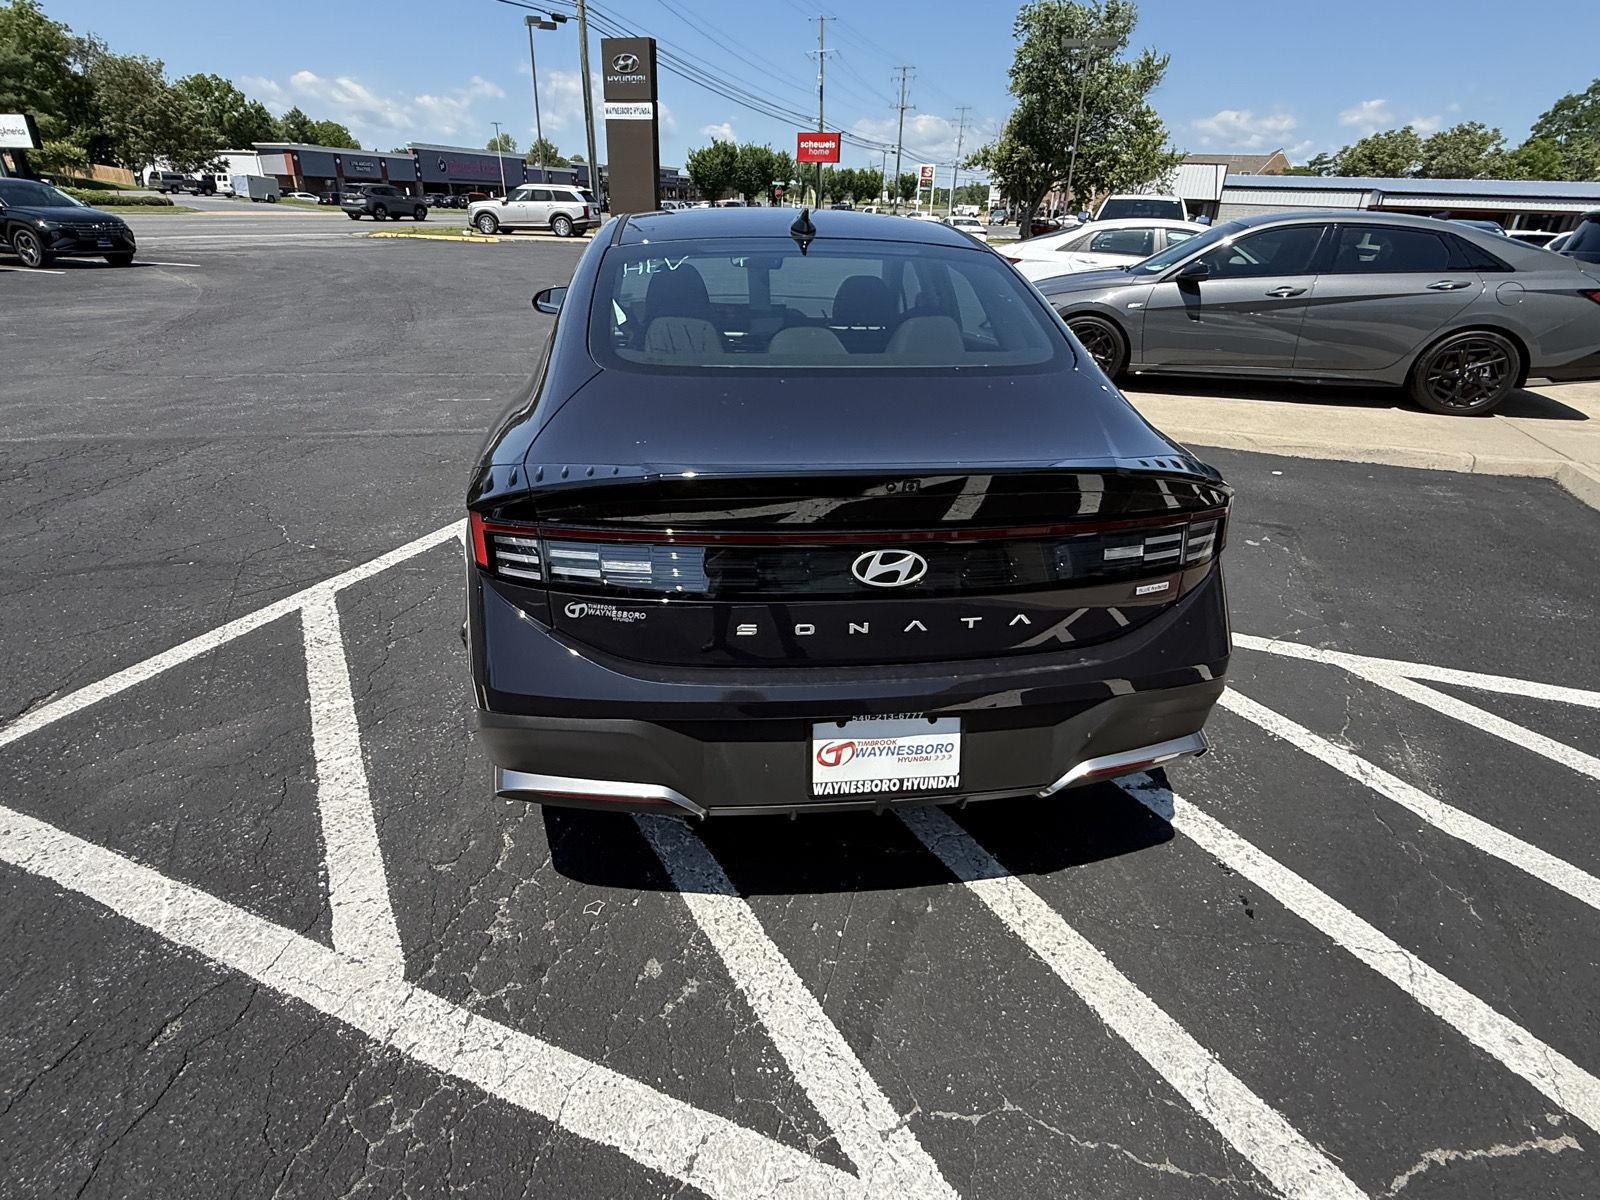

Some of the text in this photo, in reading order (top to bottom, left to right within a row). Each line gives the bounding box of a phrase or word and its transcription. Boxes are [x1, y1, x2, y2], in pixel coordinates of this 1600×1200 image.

[800, 140, 836, 149] schewels
[808, 148, 830, 156] home
[623, 255, 689, 277] HEV
[588, 609, 646, 619] WAYNESBORO
[736, 613, 1032, 637] SONATA
[852, 712, 924, 722] 540-213-6777
[857, 739, 898, 747] TIMBROOK
[855, 742, 955, 759] WAYNESBORO
[897, 755, 932, 764] HYUNDAI
[813, 775, 960, 796] WAYNESBORO HYUNDAI
